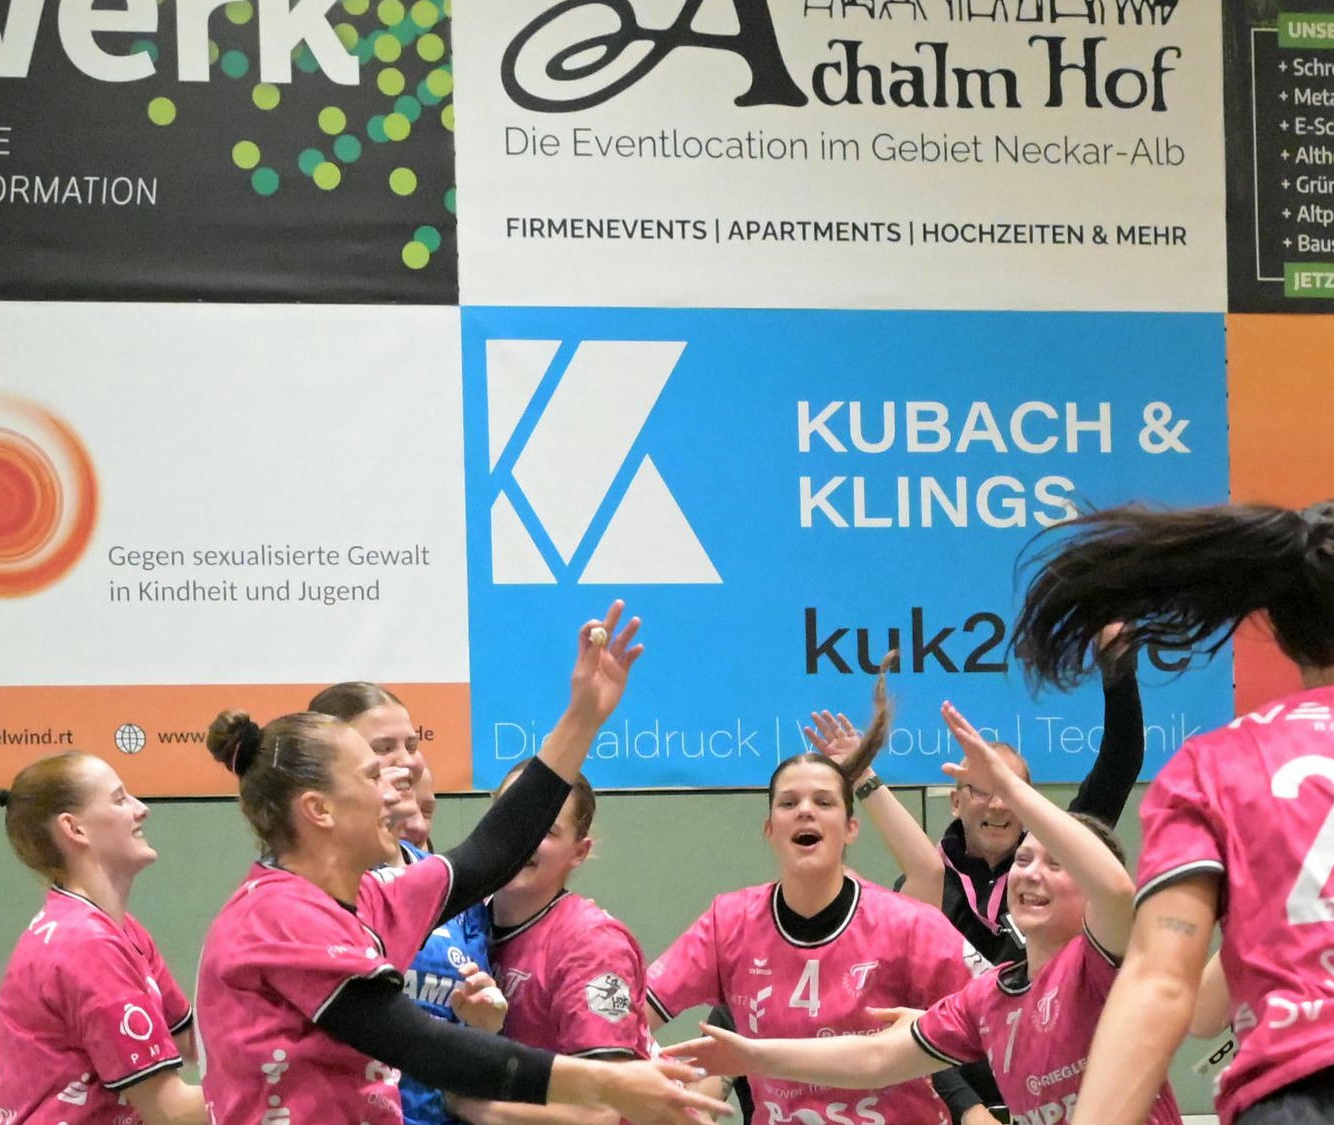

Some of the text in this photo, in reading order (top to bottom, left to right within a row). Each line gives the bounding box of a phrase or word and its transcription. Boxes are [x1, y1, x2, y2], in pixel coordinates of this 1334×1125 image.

[1028, 35, 1181, 112] Hof
[506, 127, 1184, 166] Die Eventlocation im Gebiet Neckar-Alb
[507, 218, 1186, 245] FIRMENEVENTS APARTMENTS HOCHZEITEN & MEHR
[798, 401, 1190, 454] KUBACH &
[799, 476, 1079, 529] KLINGS
[109, 545, 429, 570] Gegen sexualisierte Gewalt
[110, 580, 379, 605] in Kindheit und Jugend
[1043, 717, 1202, 752] Tecnik
[788, 959, 821, 1018] 4
[1040, 1057, 1088, 1088] RIEGLE
